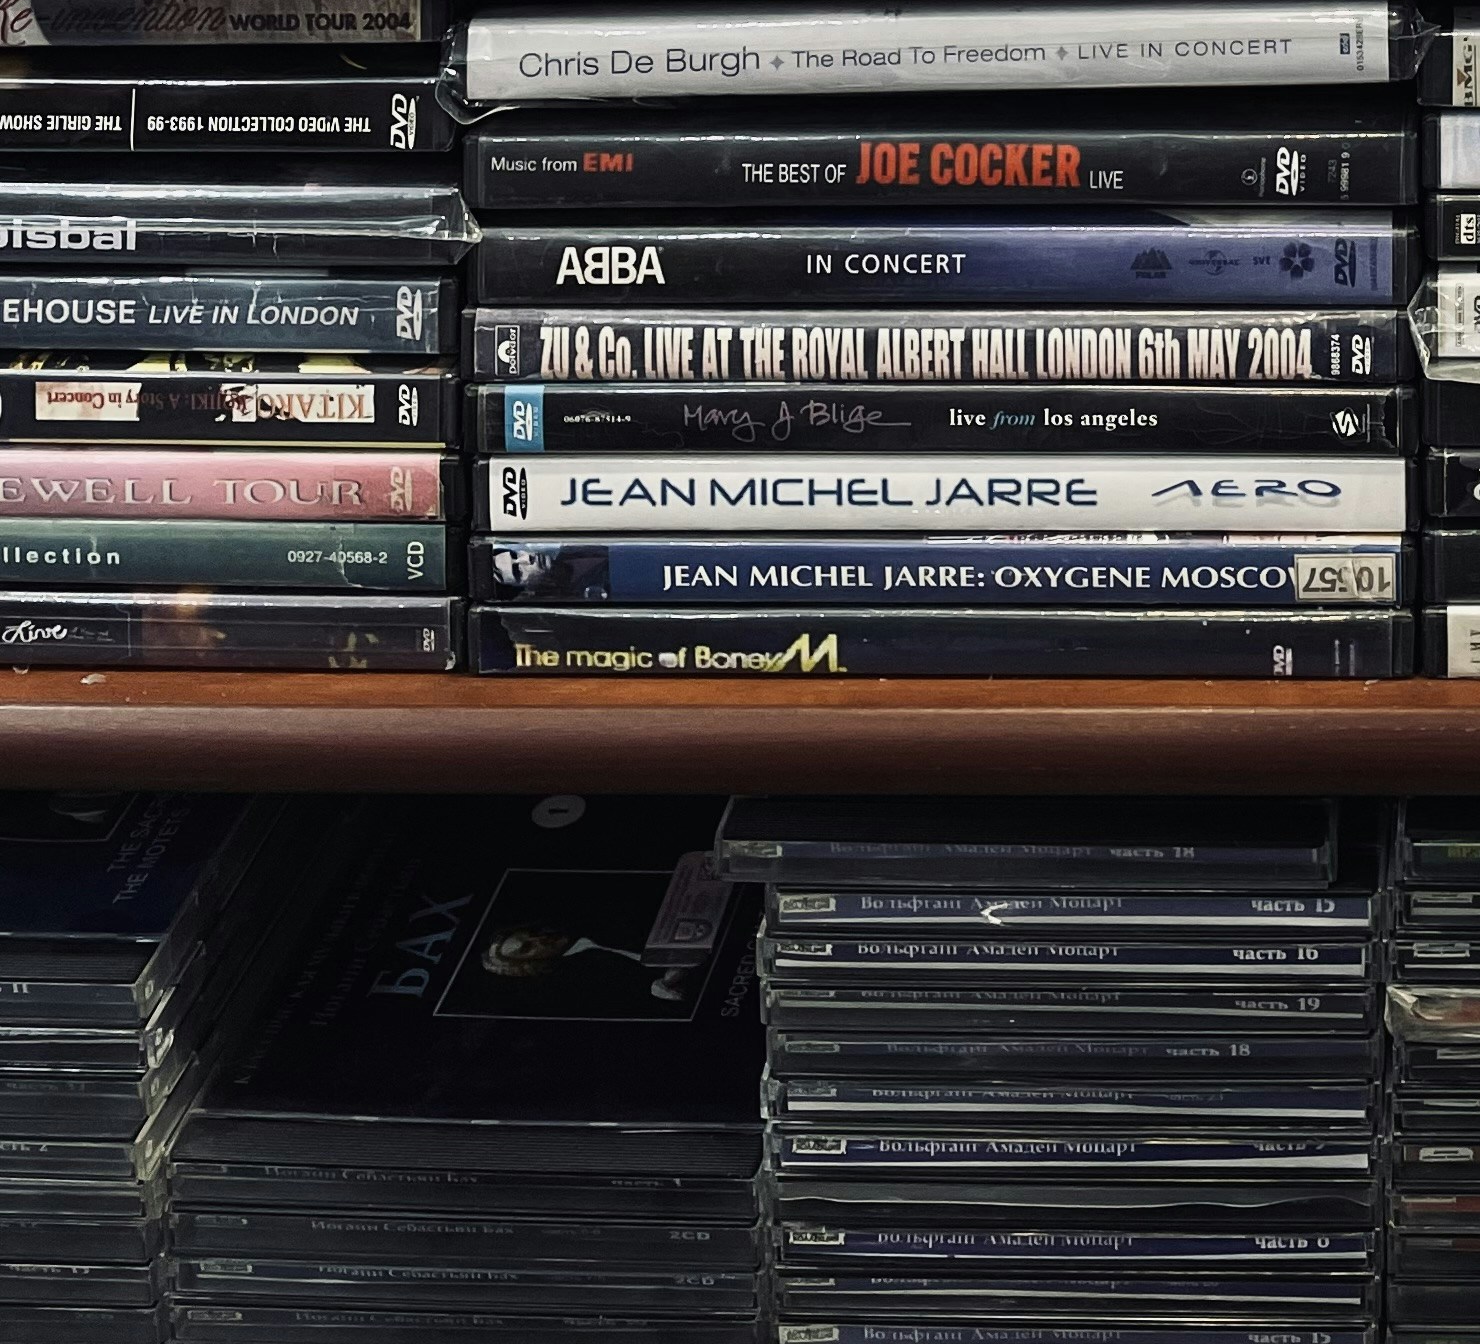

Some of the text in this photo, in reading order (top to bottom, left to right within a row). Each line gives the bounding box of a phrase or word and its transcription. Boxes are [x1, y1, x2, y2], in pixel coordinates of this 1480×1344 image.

[147, 117, 371, 132] THE VIDEO COLLECTION 1993-99
[742, 143, 1123, 190] THE BEST OF JOE COCKER LIVE
[149, 305, 359, 326] LIVE IN LONDON
[949, 408, 1158, 430] live from los angeles
[407, 541, 424, 579] VCD
[1235, 997, 1320, 1011] часть 19
[1166, 1044, 1250, 1057] часть 18
